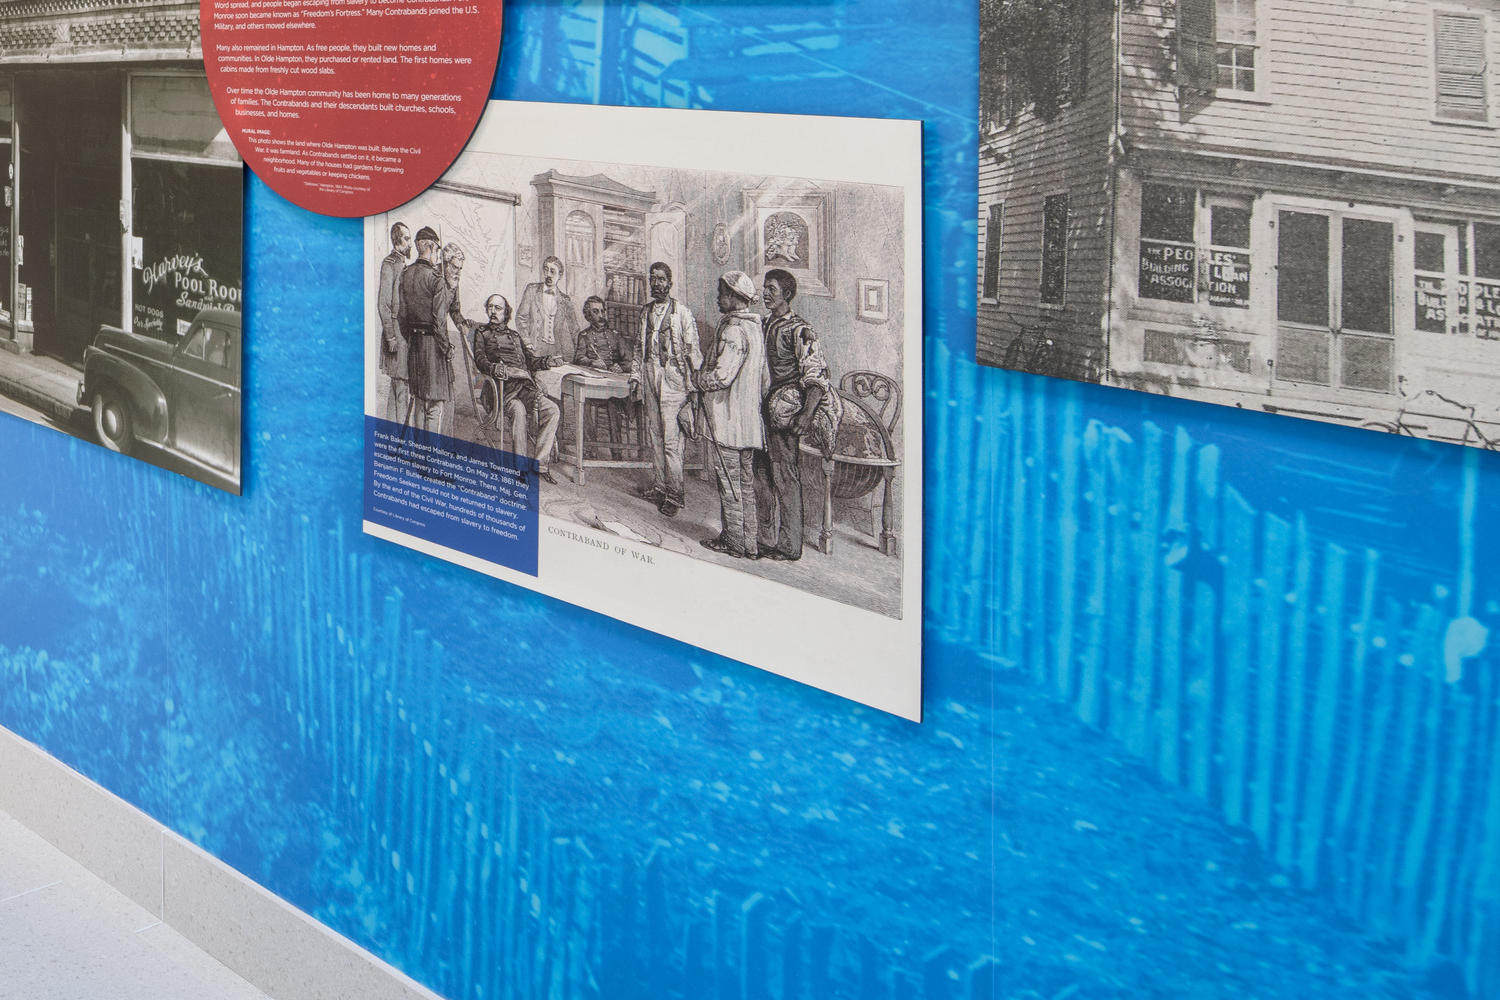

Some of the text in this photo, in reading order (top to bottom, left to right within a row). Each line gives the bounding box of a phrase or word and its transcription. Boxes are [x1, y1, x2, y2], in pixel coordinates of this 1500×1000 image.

[143, 252, 209, 294] Harvey's
[175, 272, 205, 294] POOL
[135, 304, 164, 318] HOT DOGS
[373, 442, 531, 490] were the first three Contrabands. On May 23, 1861 they
[373, 451, 529, 500] escaped from slavery to Fort Monroe. There, Maj. Gen.
[374, 430, 521, 476] Frank Baker, Shepard Mallory, and James Townsend
[373, 460, 399, 473] Benjamin
[399, 467, 405, 475] F.
[405, 469, 423, 480] Butler
[423, 476, 446, 487] created
[446, 481, 457, 490] the
[499, 496, 528, 511] doctrine:
[373, 470, 398, 483] Freedom
[399, 477, 421, 490] Seekers
[421, 485, 439, 495] would
[451, 493, 459, 501] be
[460, 497, 486, 509] returned
[487, 503, 494, 512] to
[495, 507, 519, 520] slavery.
[373, 479, 381, 489] By
[382, 482, 391, 491] the
[392, 486, 403, 494] end
[410, 491, 420, 500] the
[421, 494, 434, 504] Civil
[434, 498, 449, 509] War,
[448, 502, 477, 517] hundreds
[485, 513, 517, 529] thousands
[373, 490, 521, 541] Contrabands had escaped from slavery to freedom.
[548, 526, 655, 565] CONTRABAND OF WAR.
